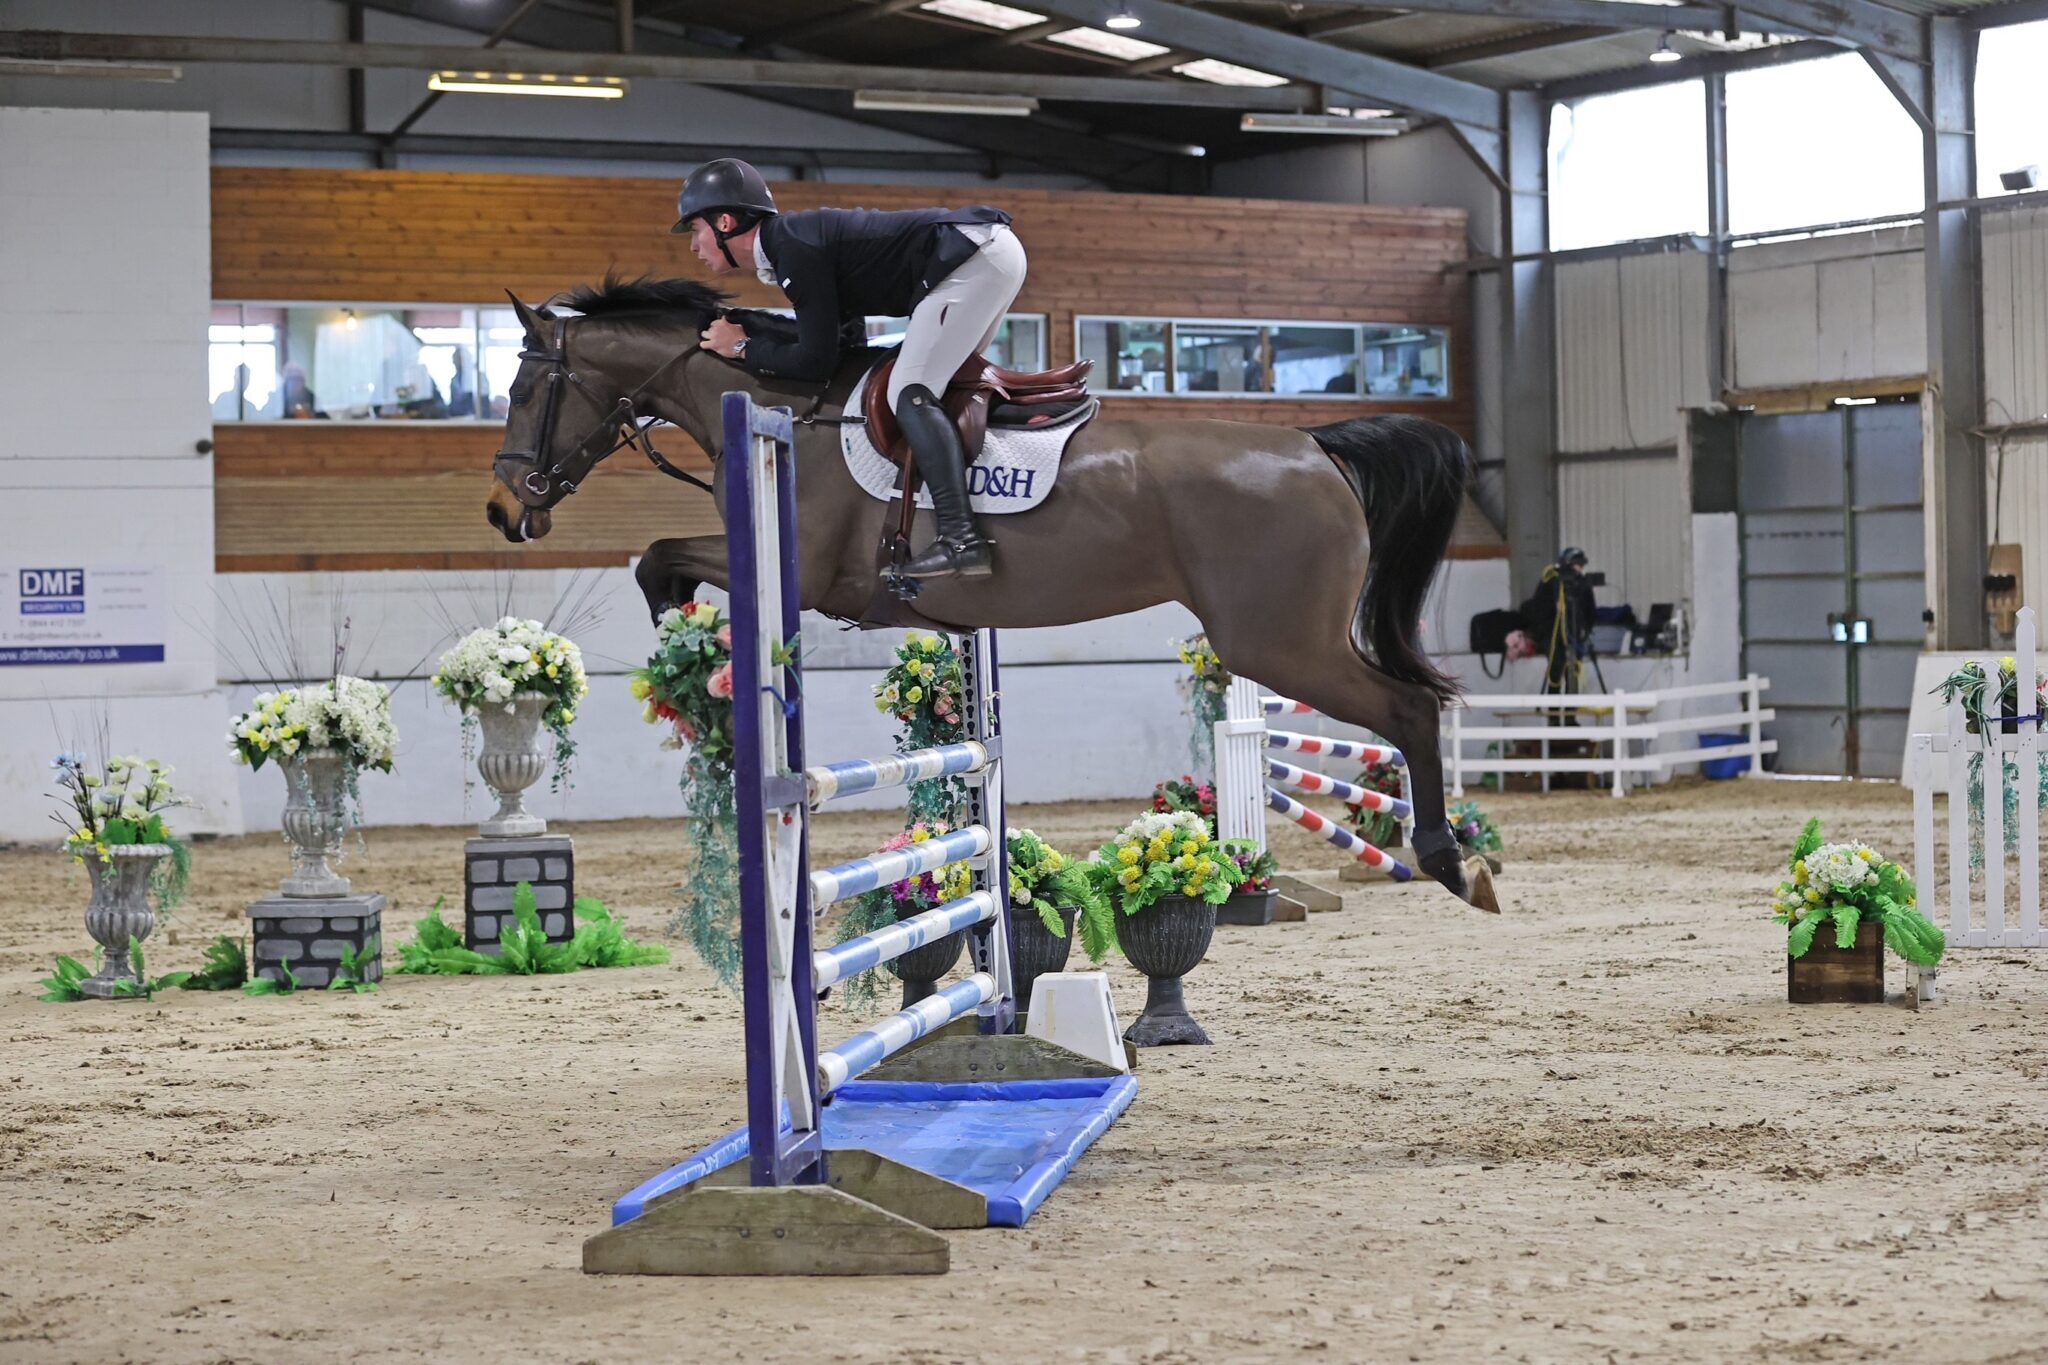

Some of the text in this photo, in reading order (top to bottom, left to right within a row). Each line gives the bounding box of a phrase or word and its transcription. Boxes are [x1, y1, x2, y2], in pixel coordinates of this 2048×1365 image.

[969, 465, 1036, 499] D&H
[22, 571, 82, 595] DMF
[23, 603, 82, 612] SECURITY LTD
